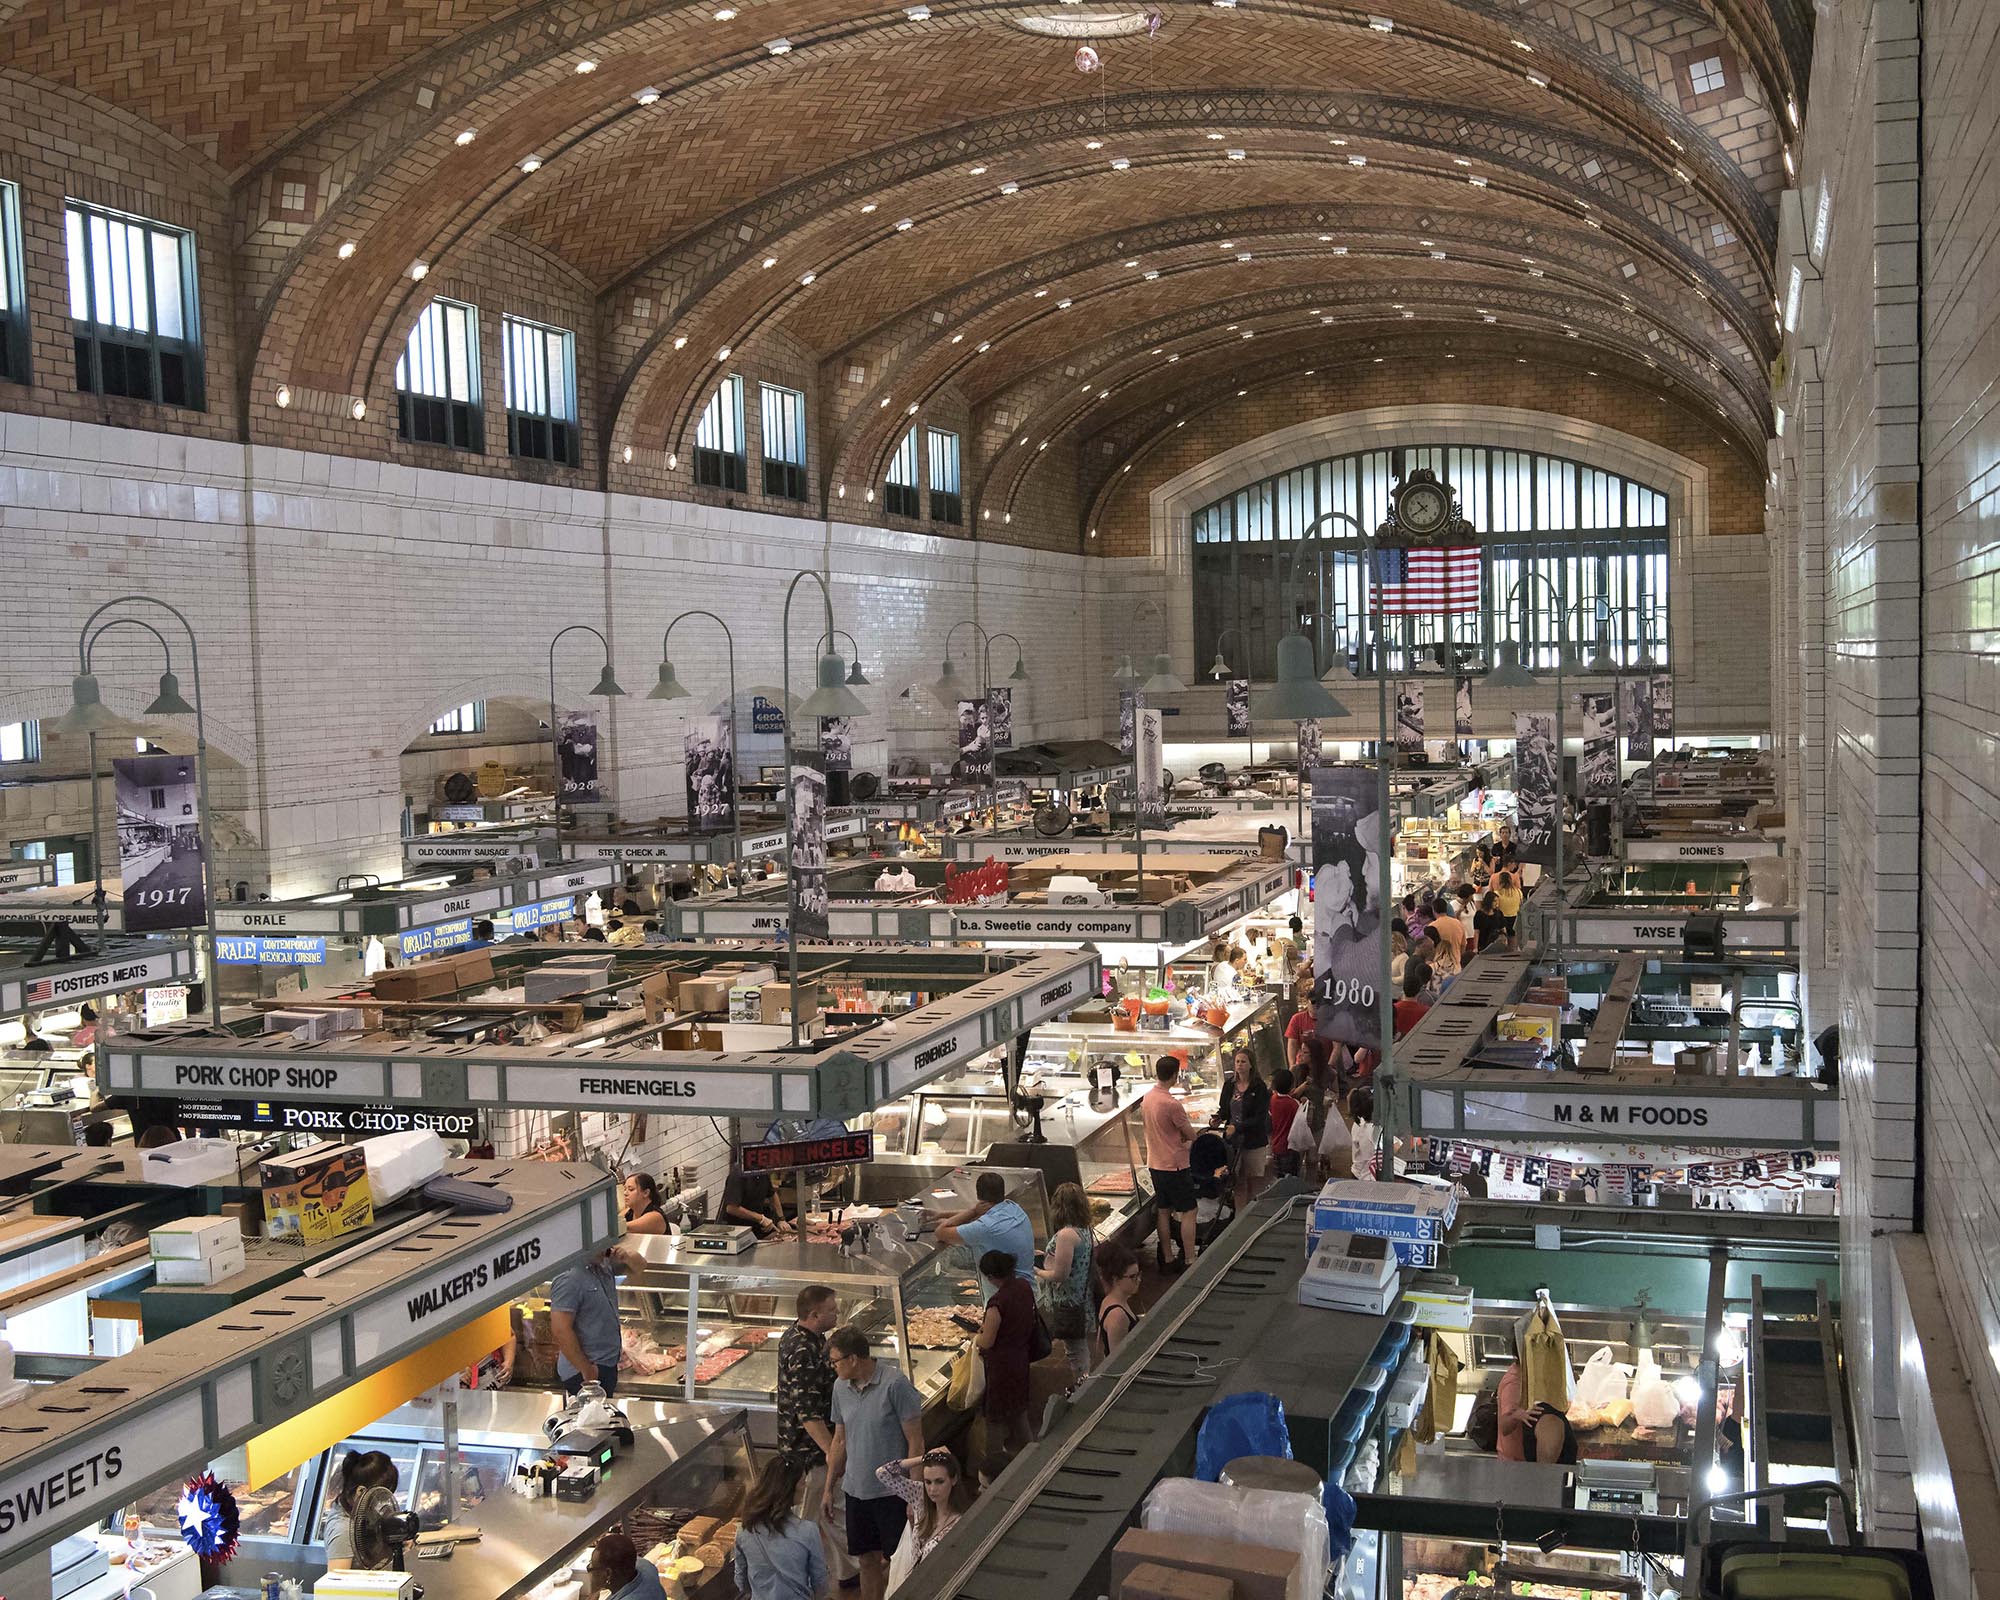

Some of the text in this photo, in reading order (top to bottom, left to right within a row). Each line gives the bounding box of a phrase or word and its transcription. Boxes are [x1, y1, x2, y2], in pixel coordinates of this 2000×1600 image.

[1629, 742, 1648, 751] 1967
[563, 781, 594, 791] 1928
[694, 803, 729, 816] 1927
[1142, 801, 1161, 814] 1976
[1523, 829, 1552, 845] 1977
[418, 848, 510, 857] OLD COUNTRY SAUSAGE
[598, 849, 668, 857] STEVE CHECK JR.
[1005, 847, 1071, 856] D.W. WHITAKER
[1679, 845, 1725, 856] DIONNE'S
[0, 874, 18, 884] KERY
[567, 876, 585, 888] ORALE
[136, 887, 192, 909] 1917
[444, 899, 471, 913] ORALE
[52, 914, 98, 924] CREAMER
[243, 915, 287, 926] ORALE
[751, 917, 781, 929] JIM'S
[960, 920, 1132, 936] b.a. Sweetie candy company
[1633, 927, 1676, 938] TAYSE
[263, 939, 319, 951] CONTEMPORARY
[403, 931, 433, 954] ORALE!
[216, 941, 257, 960] RALE!
[259, 952, 322, 963] MEXICAN CUISINE
[54, 964, 148, 995] FOSTER'S MEATS
[148, 988, 186, 1000] FOSTER'S
[1040, 981, 1073, 1008] FERNENGELS
[1322, 977, 1375, 1008] 1980
[914, 1037, 957, 1071] FERNENGELS
[175, 1064, 338, 1089] PORK CHOP SHOP
[579, 1078, 697, 1098] FERNENGELS
[192, 1113, 242, 1121] PRESERVATIVES
[283, 1108, 474, 1134] PORK CHOP SHOP
[1554, 1104, 1709, 1126] M & M FOODS
[1428, 1136, 1573, 1192] UNITED
[1602, 1163, 1654, 1195] WE
[1688, 1148, 1818, 1183] STAND
[1417, 1218, 1432, 1240] 20
[1411, 1243, 1425, 1265] 20
[407, 1237, 542, 1323] WALKER'S MEATS
[0, 1445, 123, 1535] SWEETS
